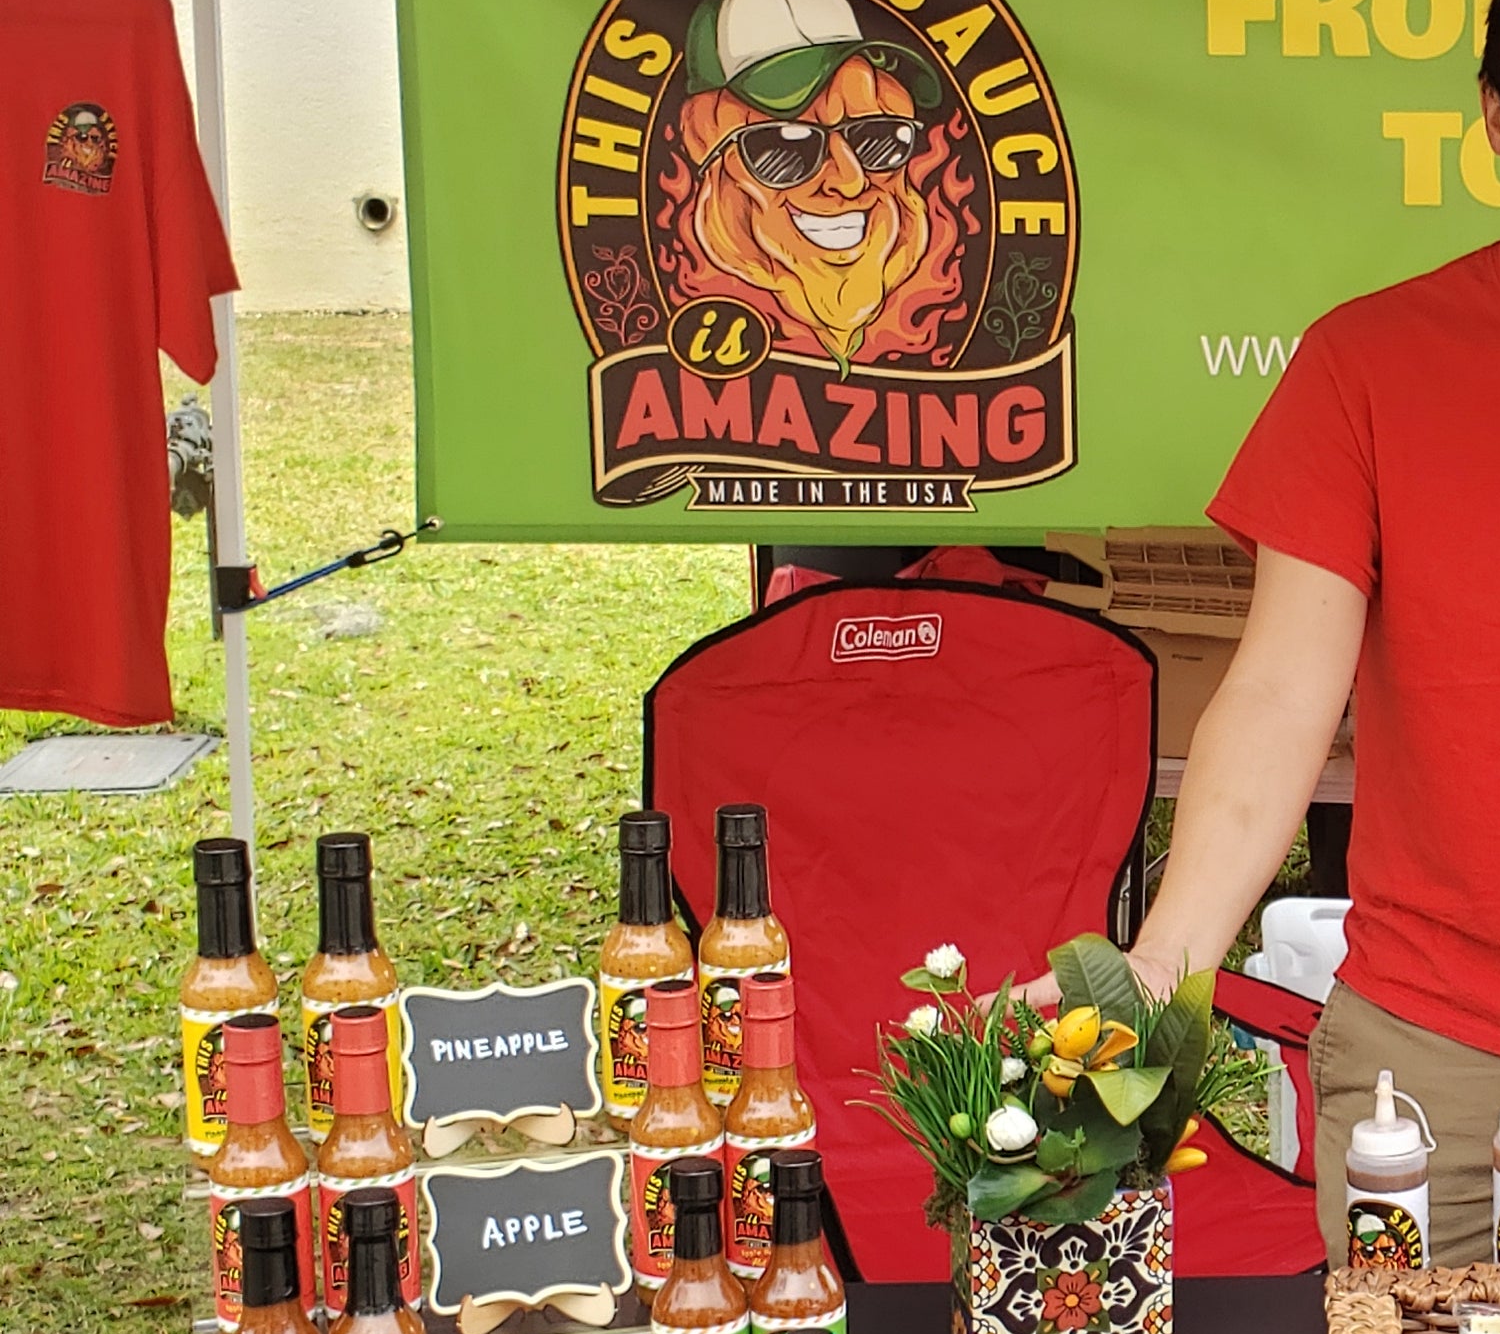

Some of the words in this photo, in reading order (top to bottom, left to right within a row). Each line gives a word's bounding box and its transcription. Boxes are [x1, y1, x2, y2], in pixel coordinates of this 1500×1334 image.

[572, 20, 673, 227] THIS
[688, 310, 751, 365] is
[616, 368, 1048, 468] AMAZING
[708, 480, 779, 504] MADE
[798, 480, 824, 504] IN
[842, 481, 888, 504] THE
[906, 482, 954, 504] USA
[840, 622, 916, 650] Coleman
[609, 1005, 624, 1039] THIS
[197, 1039, 213, 1075] THIS
[430, 1029, 569, 1062] PINEAPPLE
[645, 1175, 662, 1210] THIS
[327, 1206, 342, 1242] THIS
[482, 1209, 588, 1249] APPLE
[1389, 1209, 1423, 1267] SAUCE
